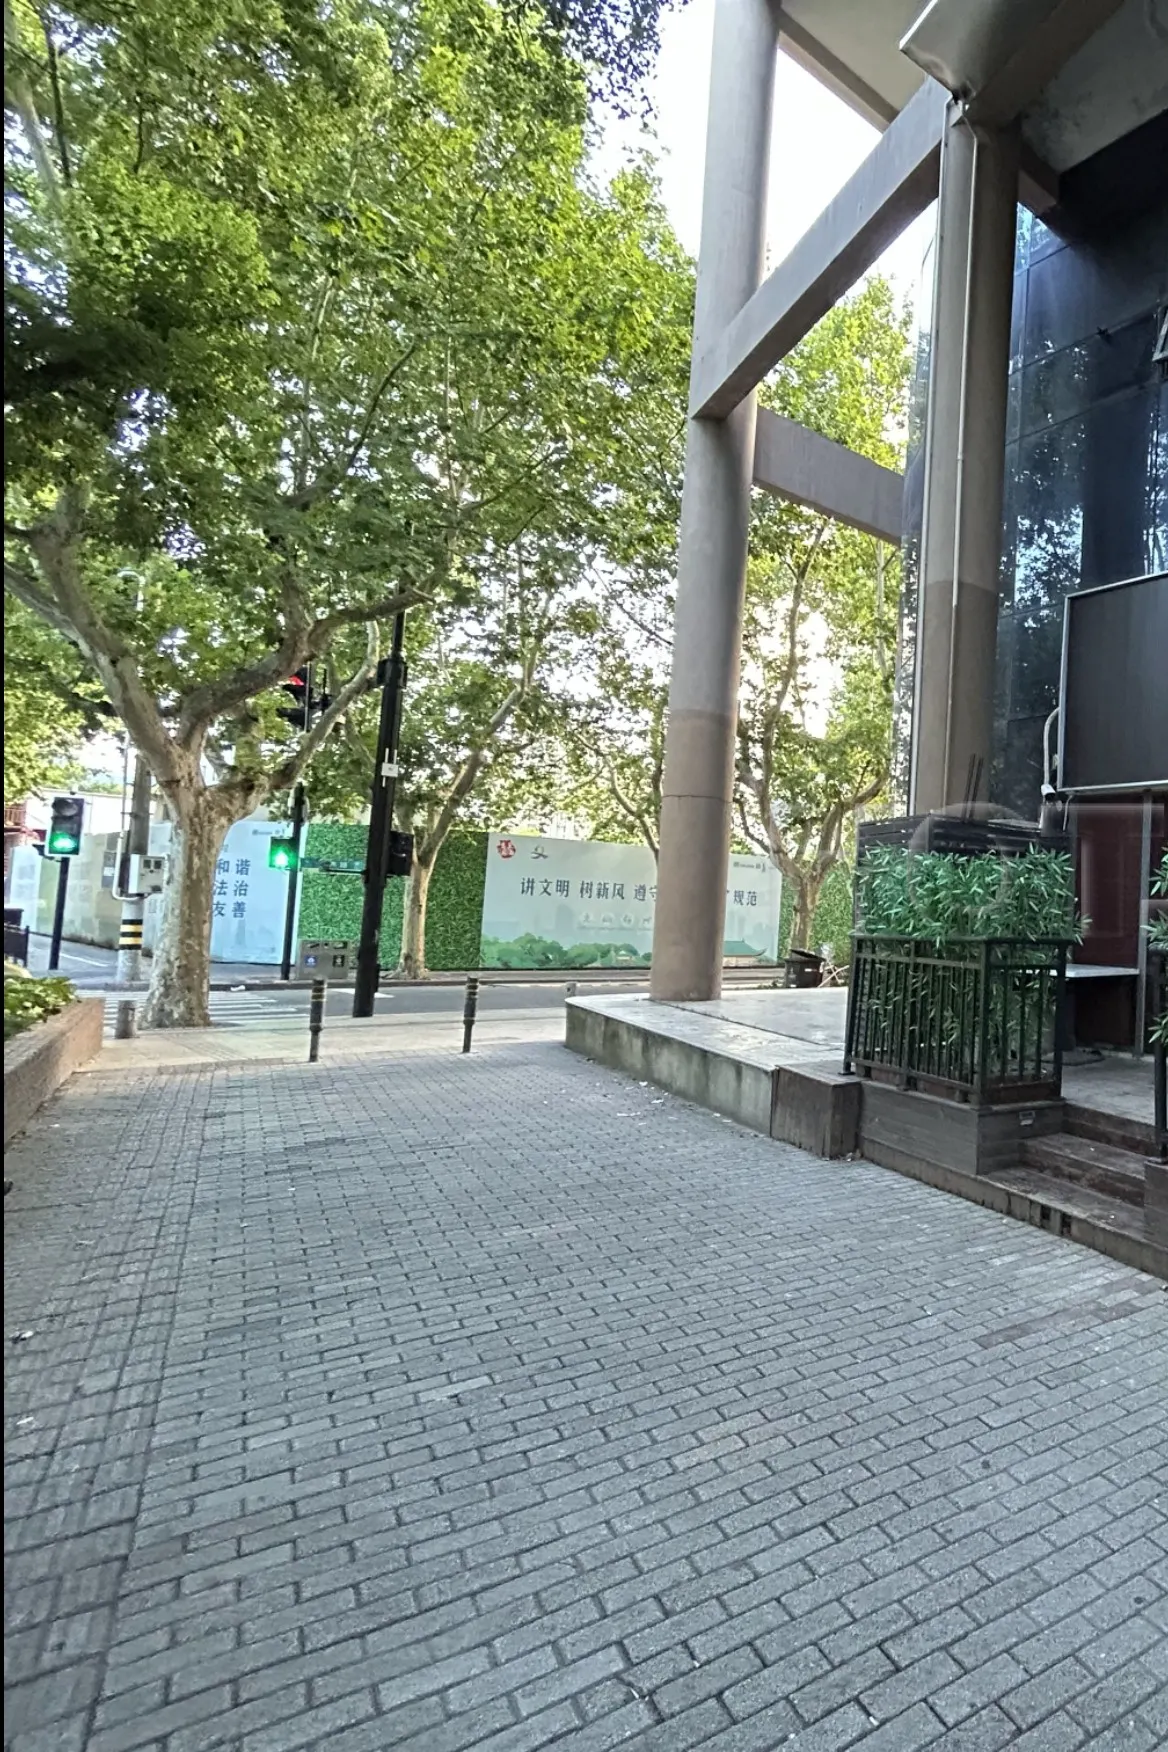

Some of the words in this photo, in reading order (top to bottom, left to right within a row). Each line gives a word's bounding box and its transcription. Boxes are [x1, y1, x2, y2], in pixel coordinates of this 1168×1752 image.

[520, 877, 570, 898] 讲文明
[579, 880, 625, 900] 树新风
